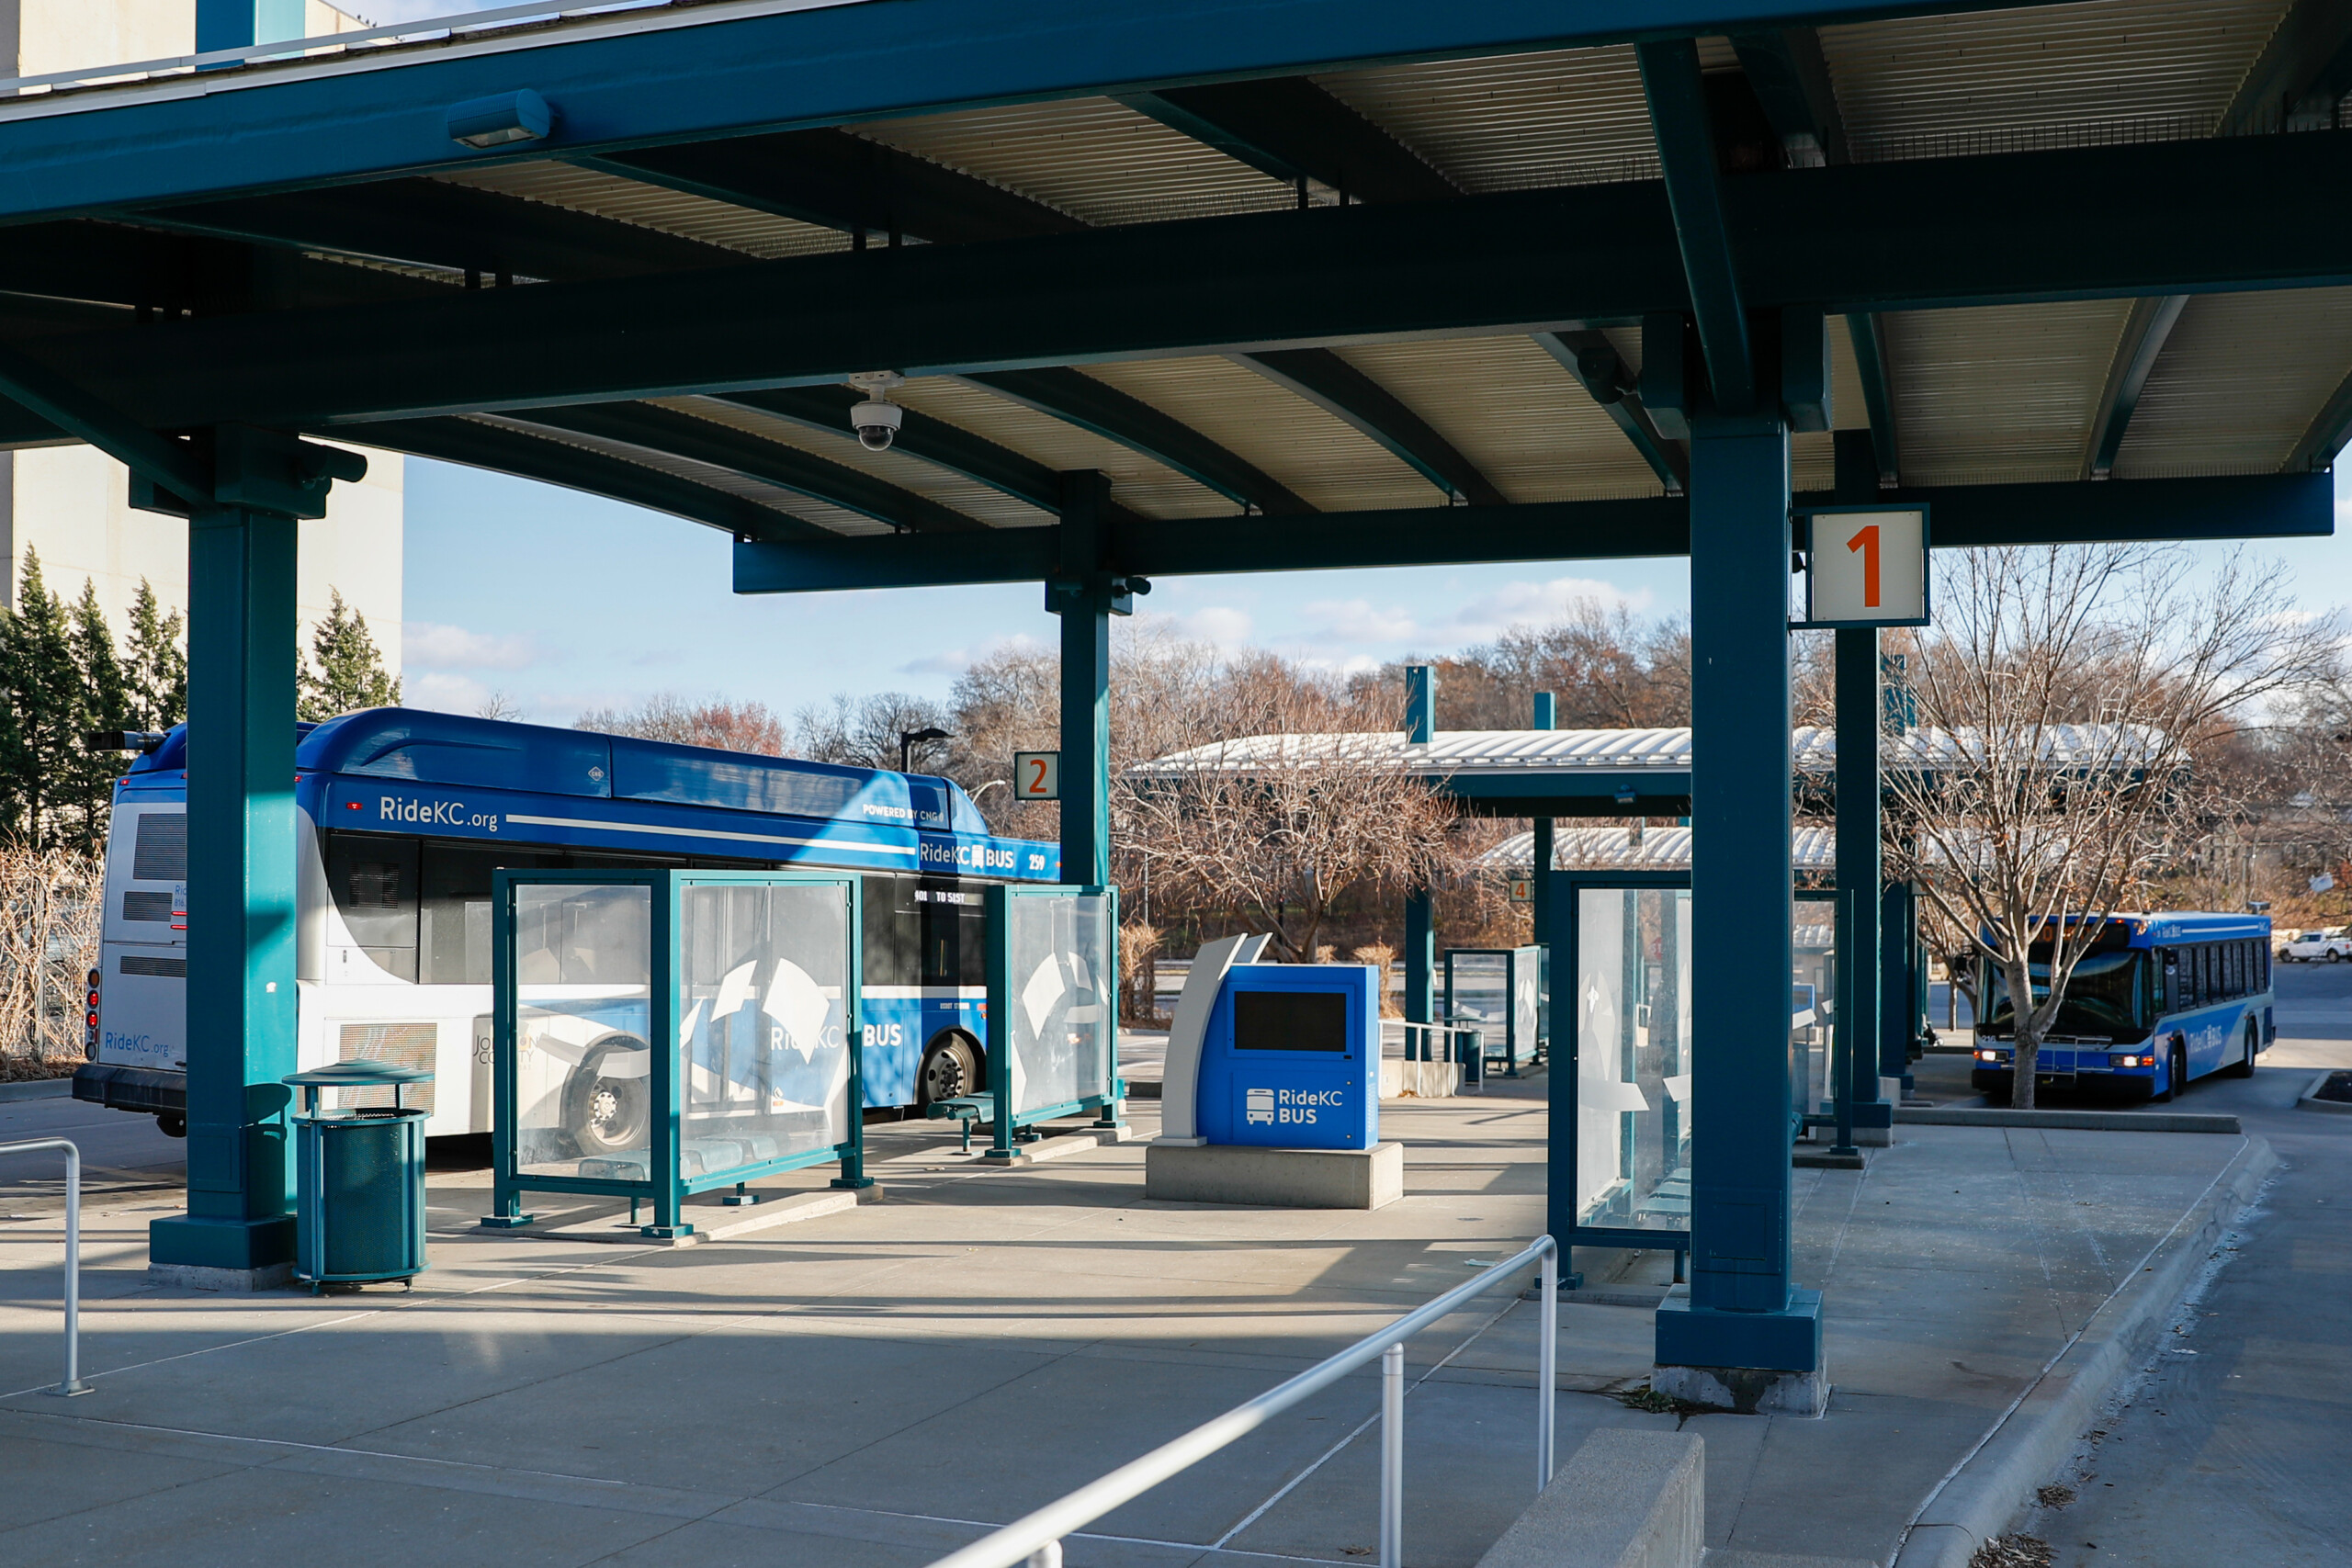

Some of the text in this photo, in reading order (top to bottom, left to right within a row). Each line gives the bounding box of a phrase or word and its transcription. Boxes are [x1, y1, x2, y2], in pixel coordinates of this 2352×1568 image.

[1847, 525, 1880, 607] 1
[1030, 759, 1047, 793] 2
[379, 796, 497, 831] RideKC.org
[863, 804, 937, 821] POWERED BY CNG
[920, 843, 1045, 871] RideKC BUS 259
[936, 891, 946, 902] TO
[947, 892, 966, 903] 51ST
[1515, 882, 1526, 898] 4
[105, 1032, 169, 1056] RideKC.org
[863, 1023, 902, 1047] BUS
[1279, 1089, 1343, 1106] RideKC
[1279, 1108, 1317, 1124] BUS
